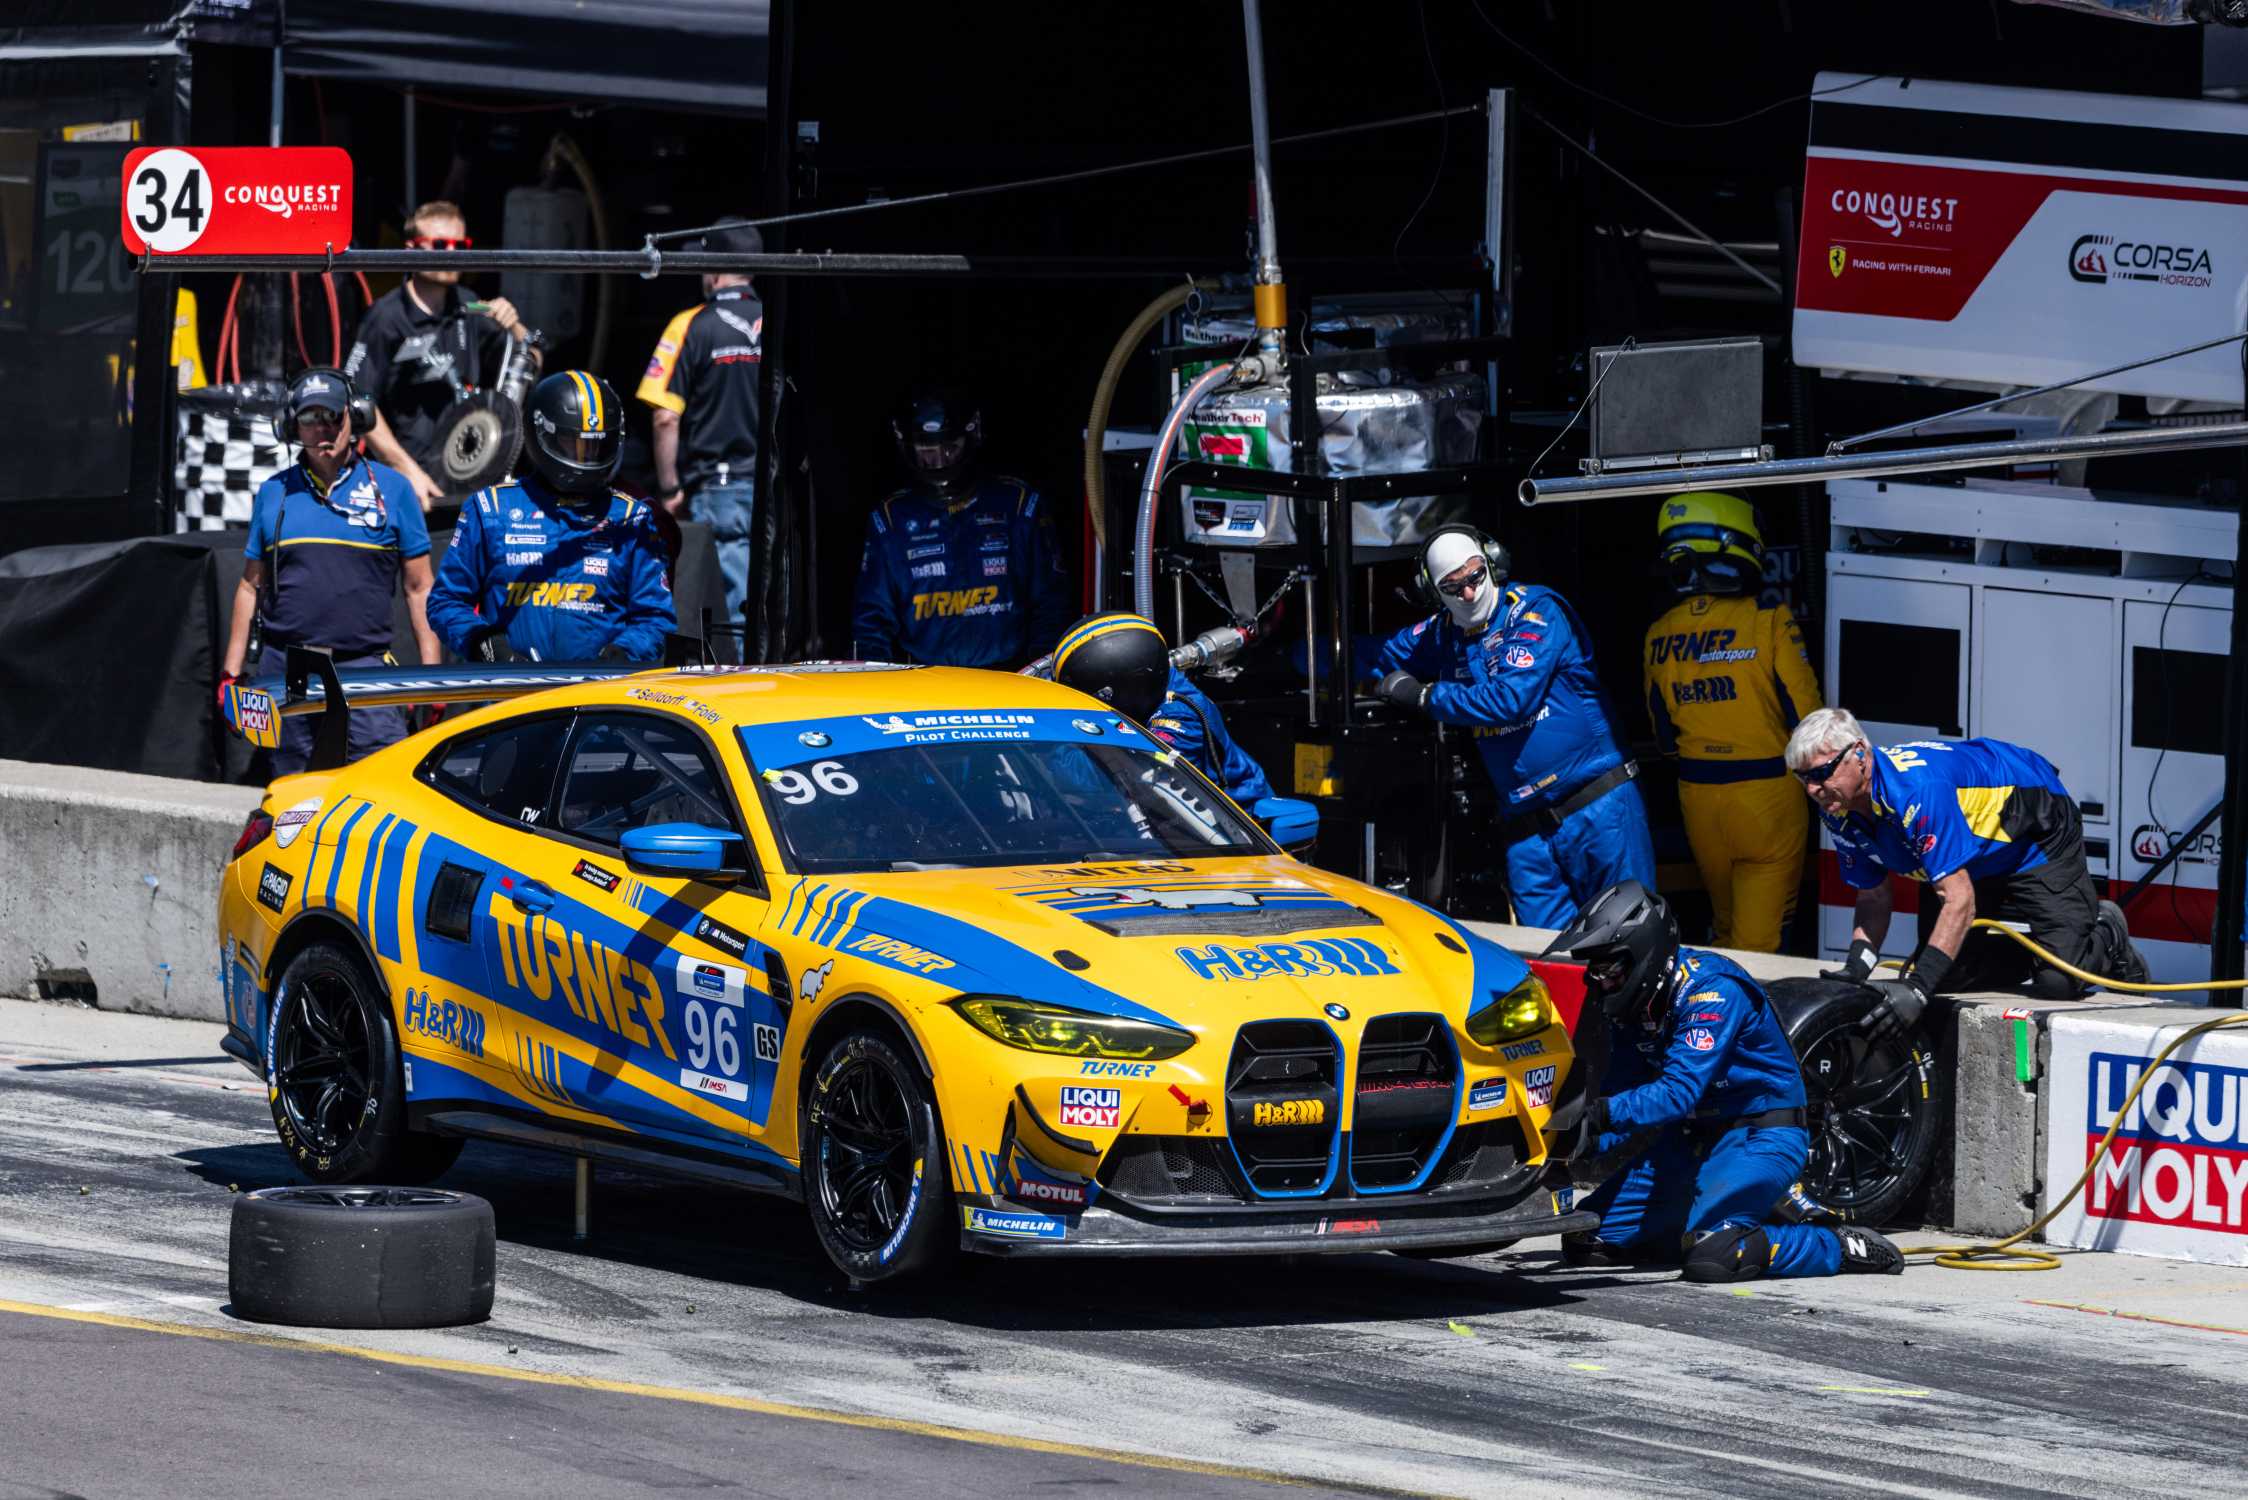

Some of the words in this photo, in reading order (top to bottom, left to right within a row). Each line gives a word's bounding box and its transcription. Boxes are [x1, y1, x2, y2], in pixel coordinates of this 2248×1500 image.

[136, 168, 204, 233] 34
[225, 185, 341, 210] CONQUEST
[1832, 189, 1958, 225] CONQUEST
[1908, 221, 1952, 232] RACING
[1852, 259, 1886, 271] RACING
[1888, 263, 1913, 273] WITH
[1914, 265, 1951, 276] FERRARI
[2114, 243, 2212, 274] CORSA
[2160, 274, 2211, 288] HORIZON
[506, 582, 596, 607] TURNER
[913, 586, 998, 620] TURNER
[1650, 629, 1736, 665] TURNER
[1699, 648, 1757, 664] motorsport
[243, 692, 268, 712] LIQUI
[242, 710, 268, 730] MOLY
[915, 715, 1034, 726] MICHELIN
[905, 730, 946, 743] PILOT
[951, 729, 1030, 740] CHALLENGE
[776, 761, 859, 805] 96
[1012, 865, 1195, 878] NITED
[268, 872, 289, 893] PAGID
[846, 933, 957, 974] TURNER
[489, 891, 679, 1062] TURNER
[684, 1000, 741, 1077] 96
[757, 1027, 778, 1060] GS
[1500, 1039, 1547, 1061] TURNER
[1080, 1061, 1156, 1077] TURNER
[1526, 1067, 1555, 1088] LIQUI
[1063, 1088, 1118, 1106] LIQUI
[1528, 1086, 1553, 1107] MOLY
[1062, 1107, 1119, 1126] MOLY
[1020, 1182, 1083, 1202] MOTUL
[2093, 1142, 2248, 1226] MOLY
[883, 1191, 917, 1260] MICHELIN
[987, 1218, 1055, 1231] MICHELIN
